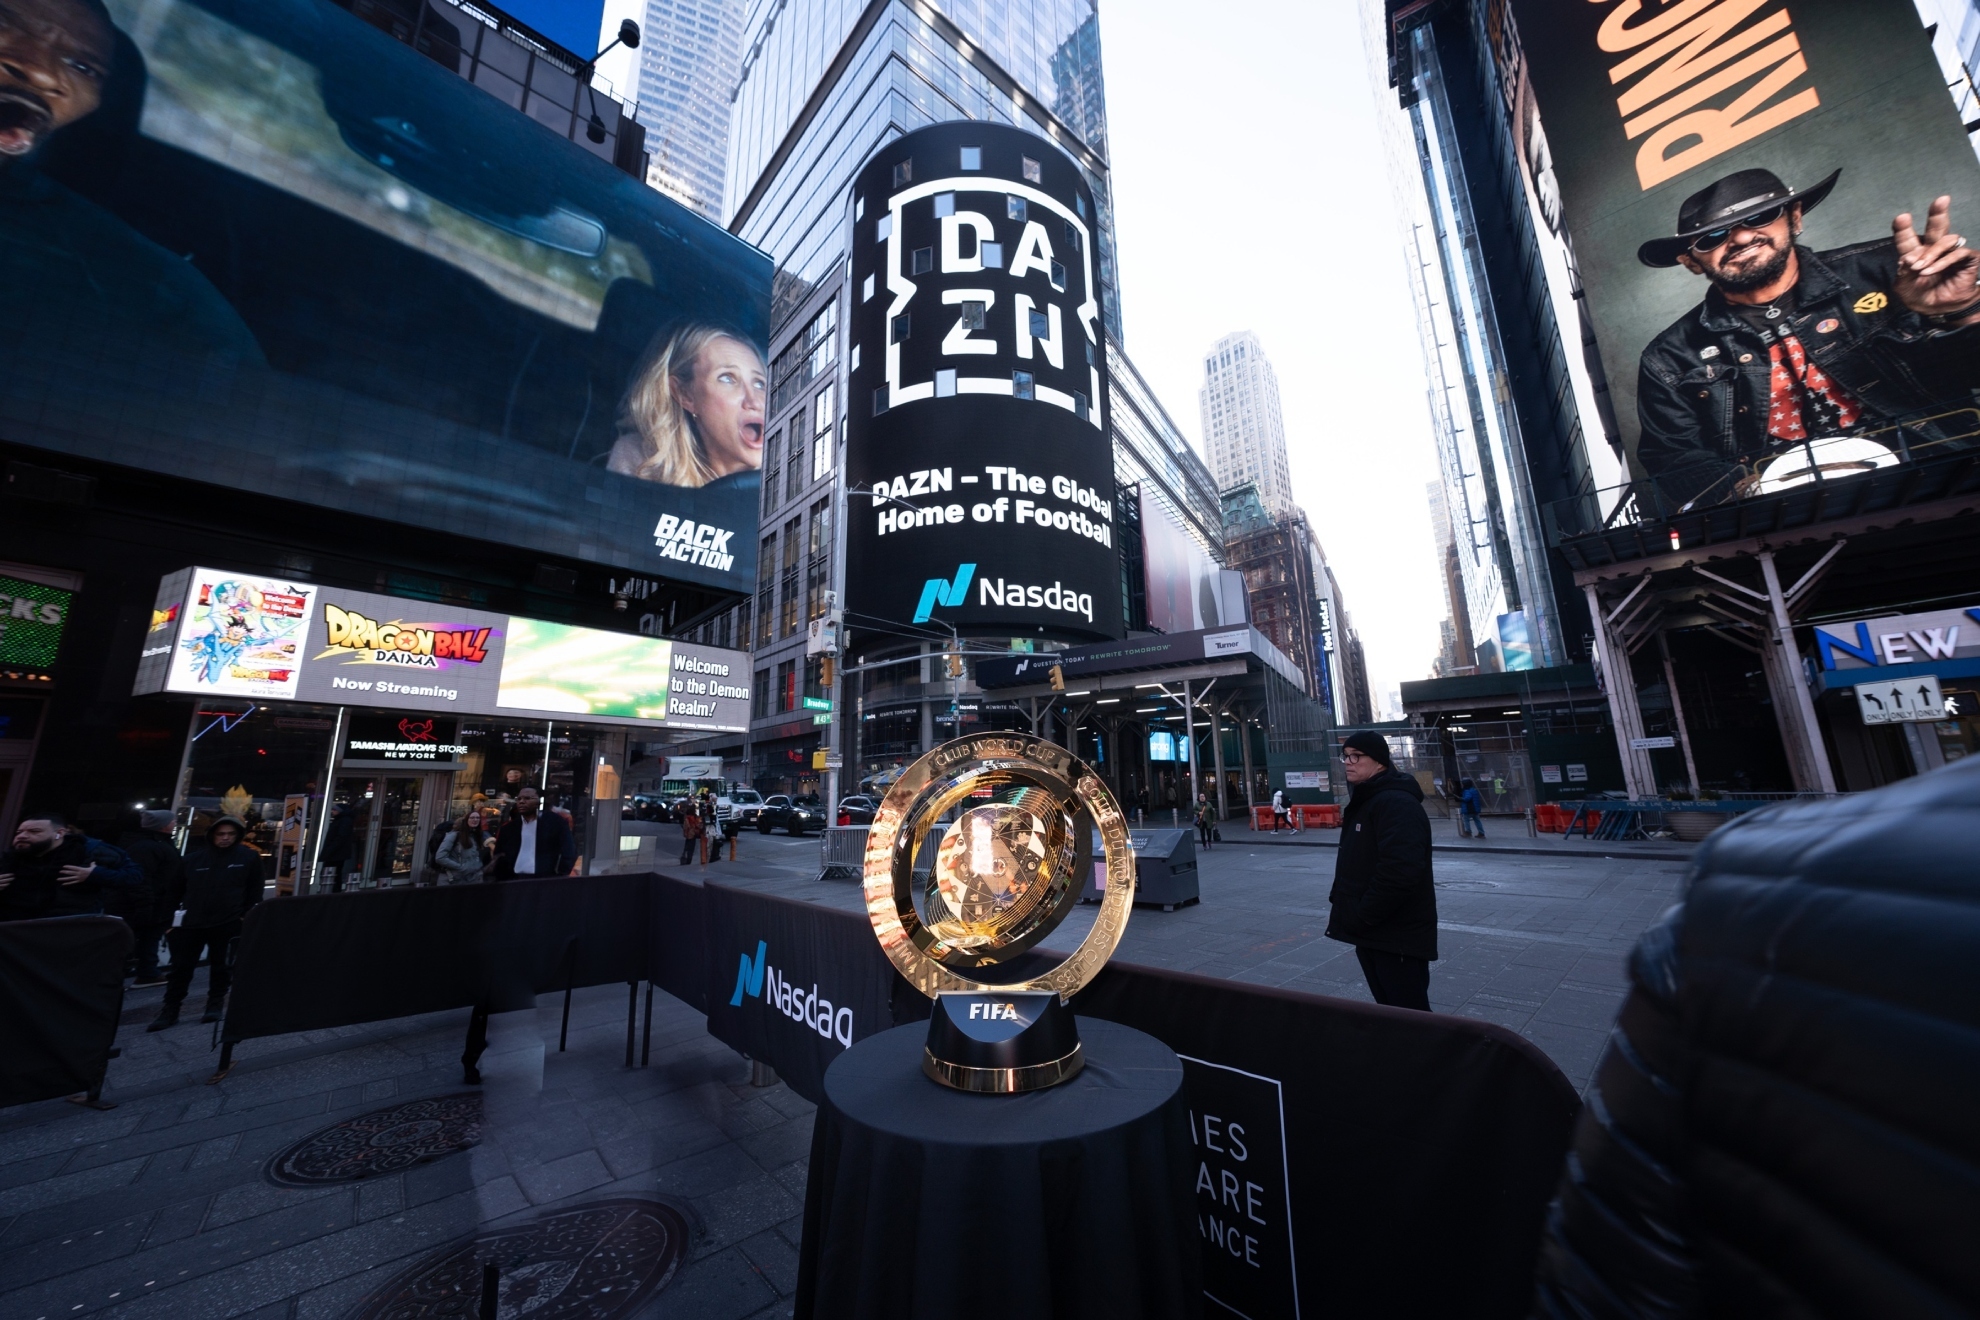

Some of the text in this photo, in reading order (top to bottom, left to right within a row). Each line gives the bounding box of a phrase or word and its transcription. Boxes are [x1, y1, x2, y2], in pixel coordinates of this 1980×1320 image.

[872, 467, 952, 507] DAZN
[985, 466, 1046, 494] The
[1052, 475, 1112, 523] Global
[653, 513, 735, 554] BACK
[878, 497, 1111, 549] Home of Football
[655, 537, 668, 547] IN
[659, 540, 734, 572] ACTION
[980, 578, 1093, 623] Nasdaq
[376, 650, 437, 667] DAIMA
[674, 653, 729, 676] Welcome
[1064, 656, 1085, 664] TODAY
[1090, 651, 1123, 660] REWRITE
[332, 677, 458, 701] Now Streaming
[671, 677, 749, 699] to the Demon
[669, 697, 717, 717] Realm!
[807, 698, 829, 710] Broadway
[1890, 711, 1913, 719] ONLY
[1918, 709, 1942, 717] ONLY
[1866, 713, 1887, 721] ONLY
[438, 745, 468, 754] STORE
[936, 744, 971, 766] CLUB
[971, 739, 1024, 752] WORLD
[1026, 744, 1056, 761] CUP
[1108, 829, 1125, 852] DU
[1108, 854, 1127, 919] MONDE
[1093, 920, 1116, 950] DES
[1056, 948, 1099, 989] CLUBS
[767, 966, 853, 1049] Nasdaq
[969, 1003, 1018, 1020] FIFA
